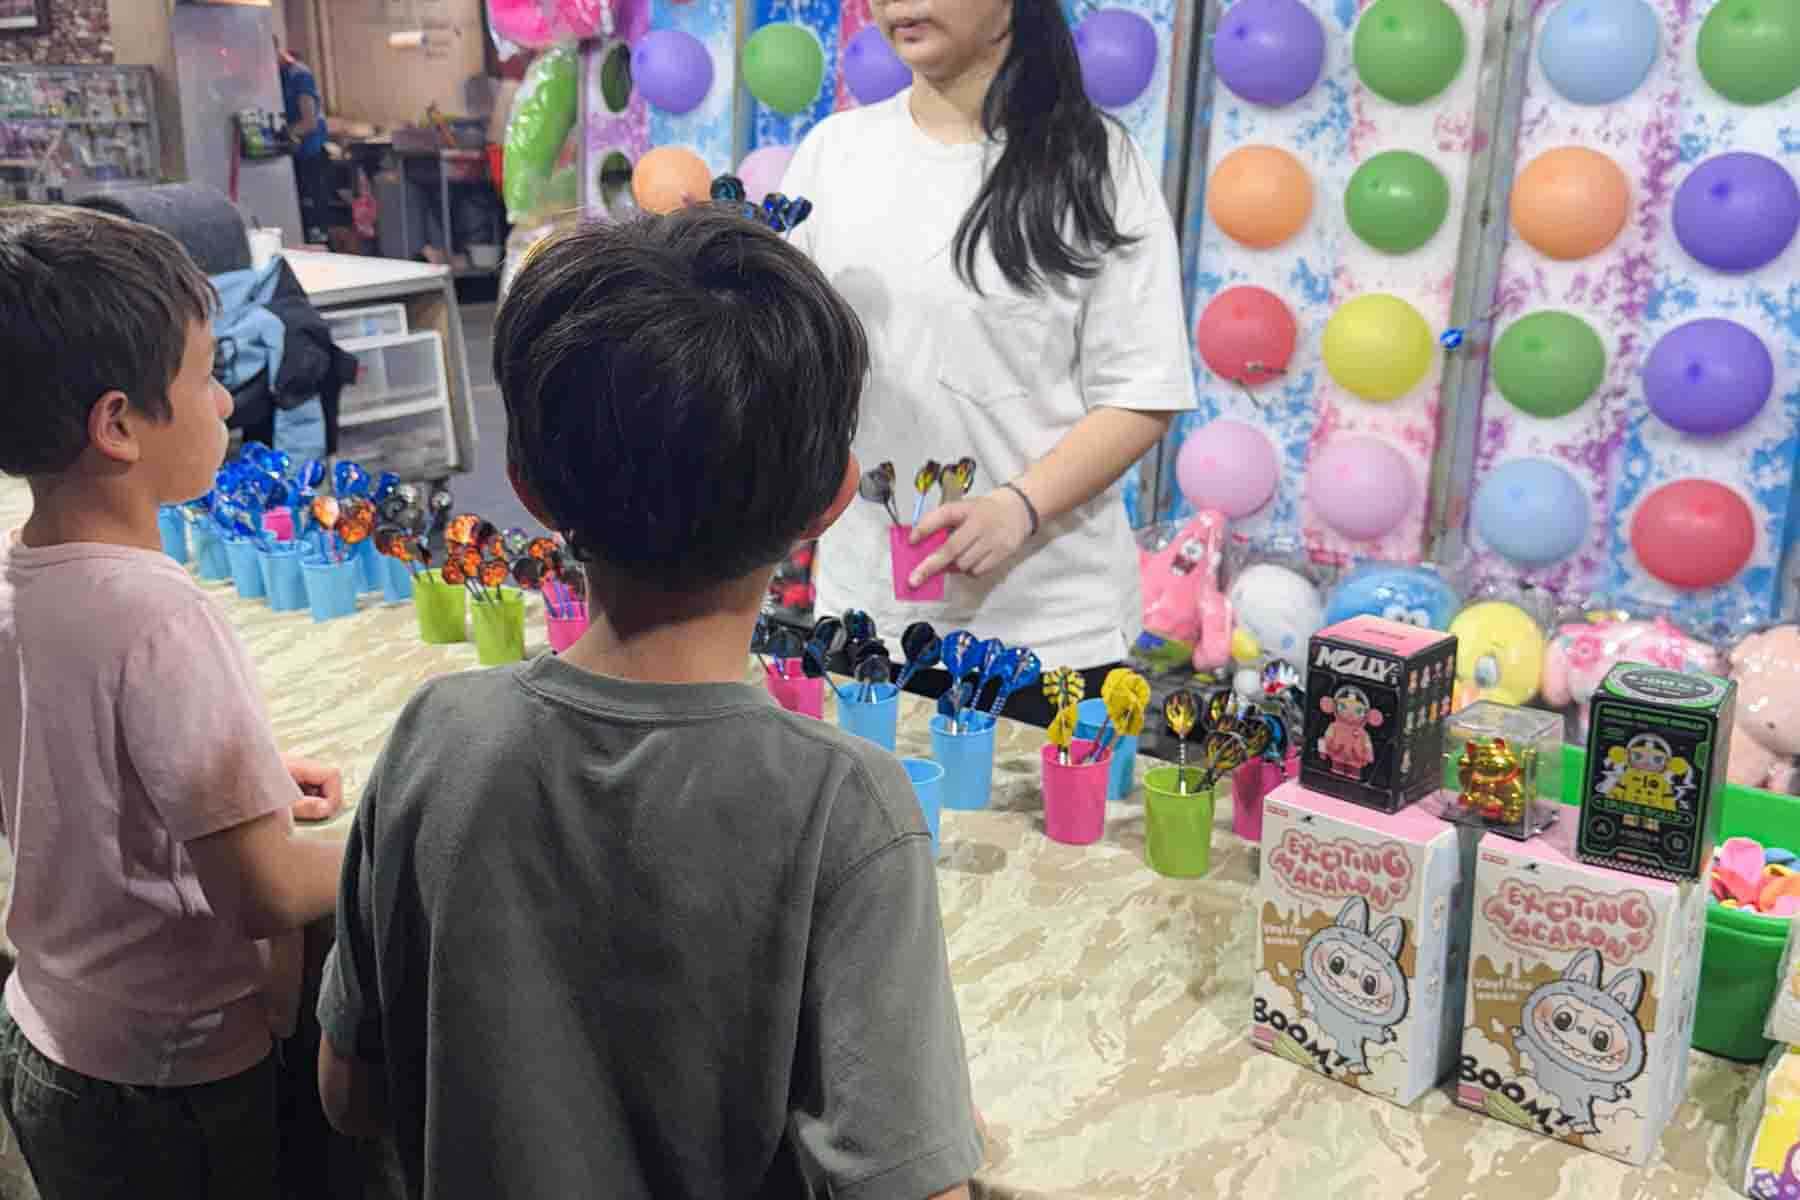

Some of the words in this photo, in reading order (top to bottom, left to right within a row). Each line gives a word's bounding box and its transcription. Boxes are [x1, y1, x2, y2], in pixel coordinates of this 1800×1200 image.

[1315, 645, 1398, 682] MOLLY
[1288, 834, 1406, 878] EXCITING
[1508, 885, 1649, 929] EXCITING
